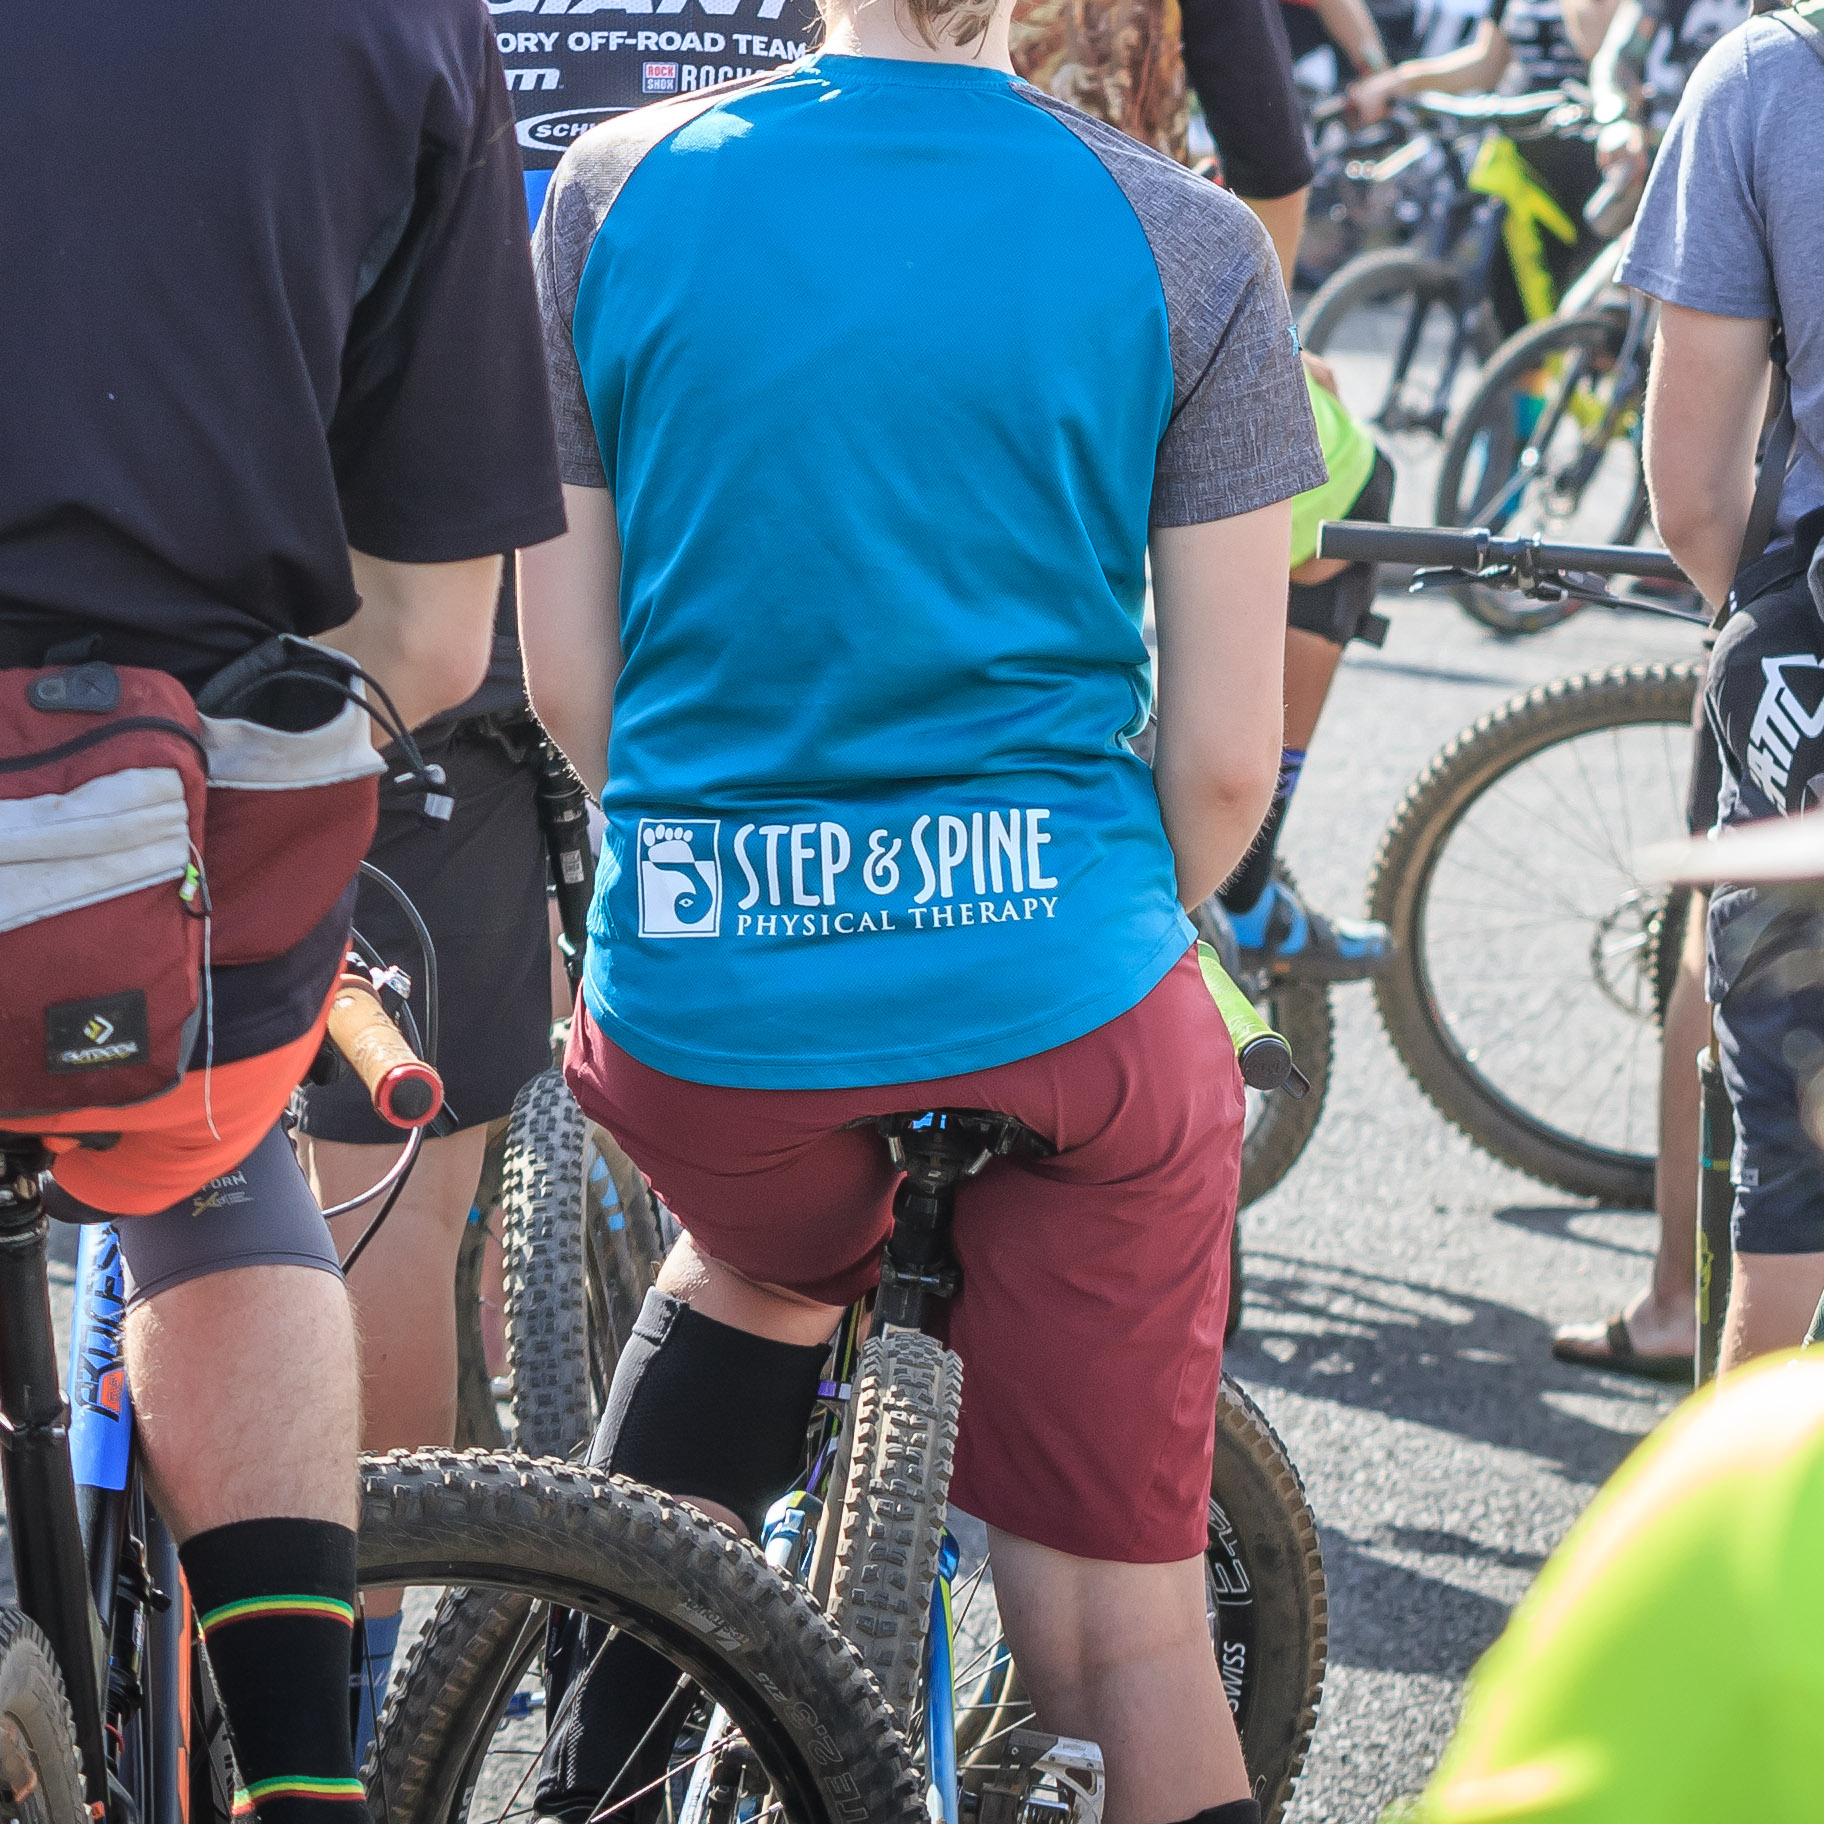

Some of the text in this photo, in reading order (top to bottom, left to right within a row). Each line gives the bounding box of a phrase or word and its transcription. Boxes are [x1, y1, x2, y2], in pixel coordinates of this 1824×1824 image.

[567, 30, 727, 54] OFF-ROAD
[731, 33, 809, 62] TEAM
[646, 78, 675, 91] SHOX
[647, 65, 675, 78] ROCK
[733, 808, 1059, 911] STEP & SPINE
[735, 896, 1060, 937] PHYSICAL THERAPY
